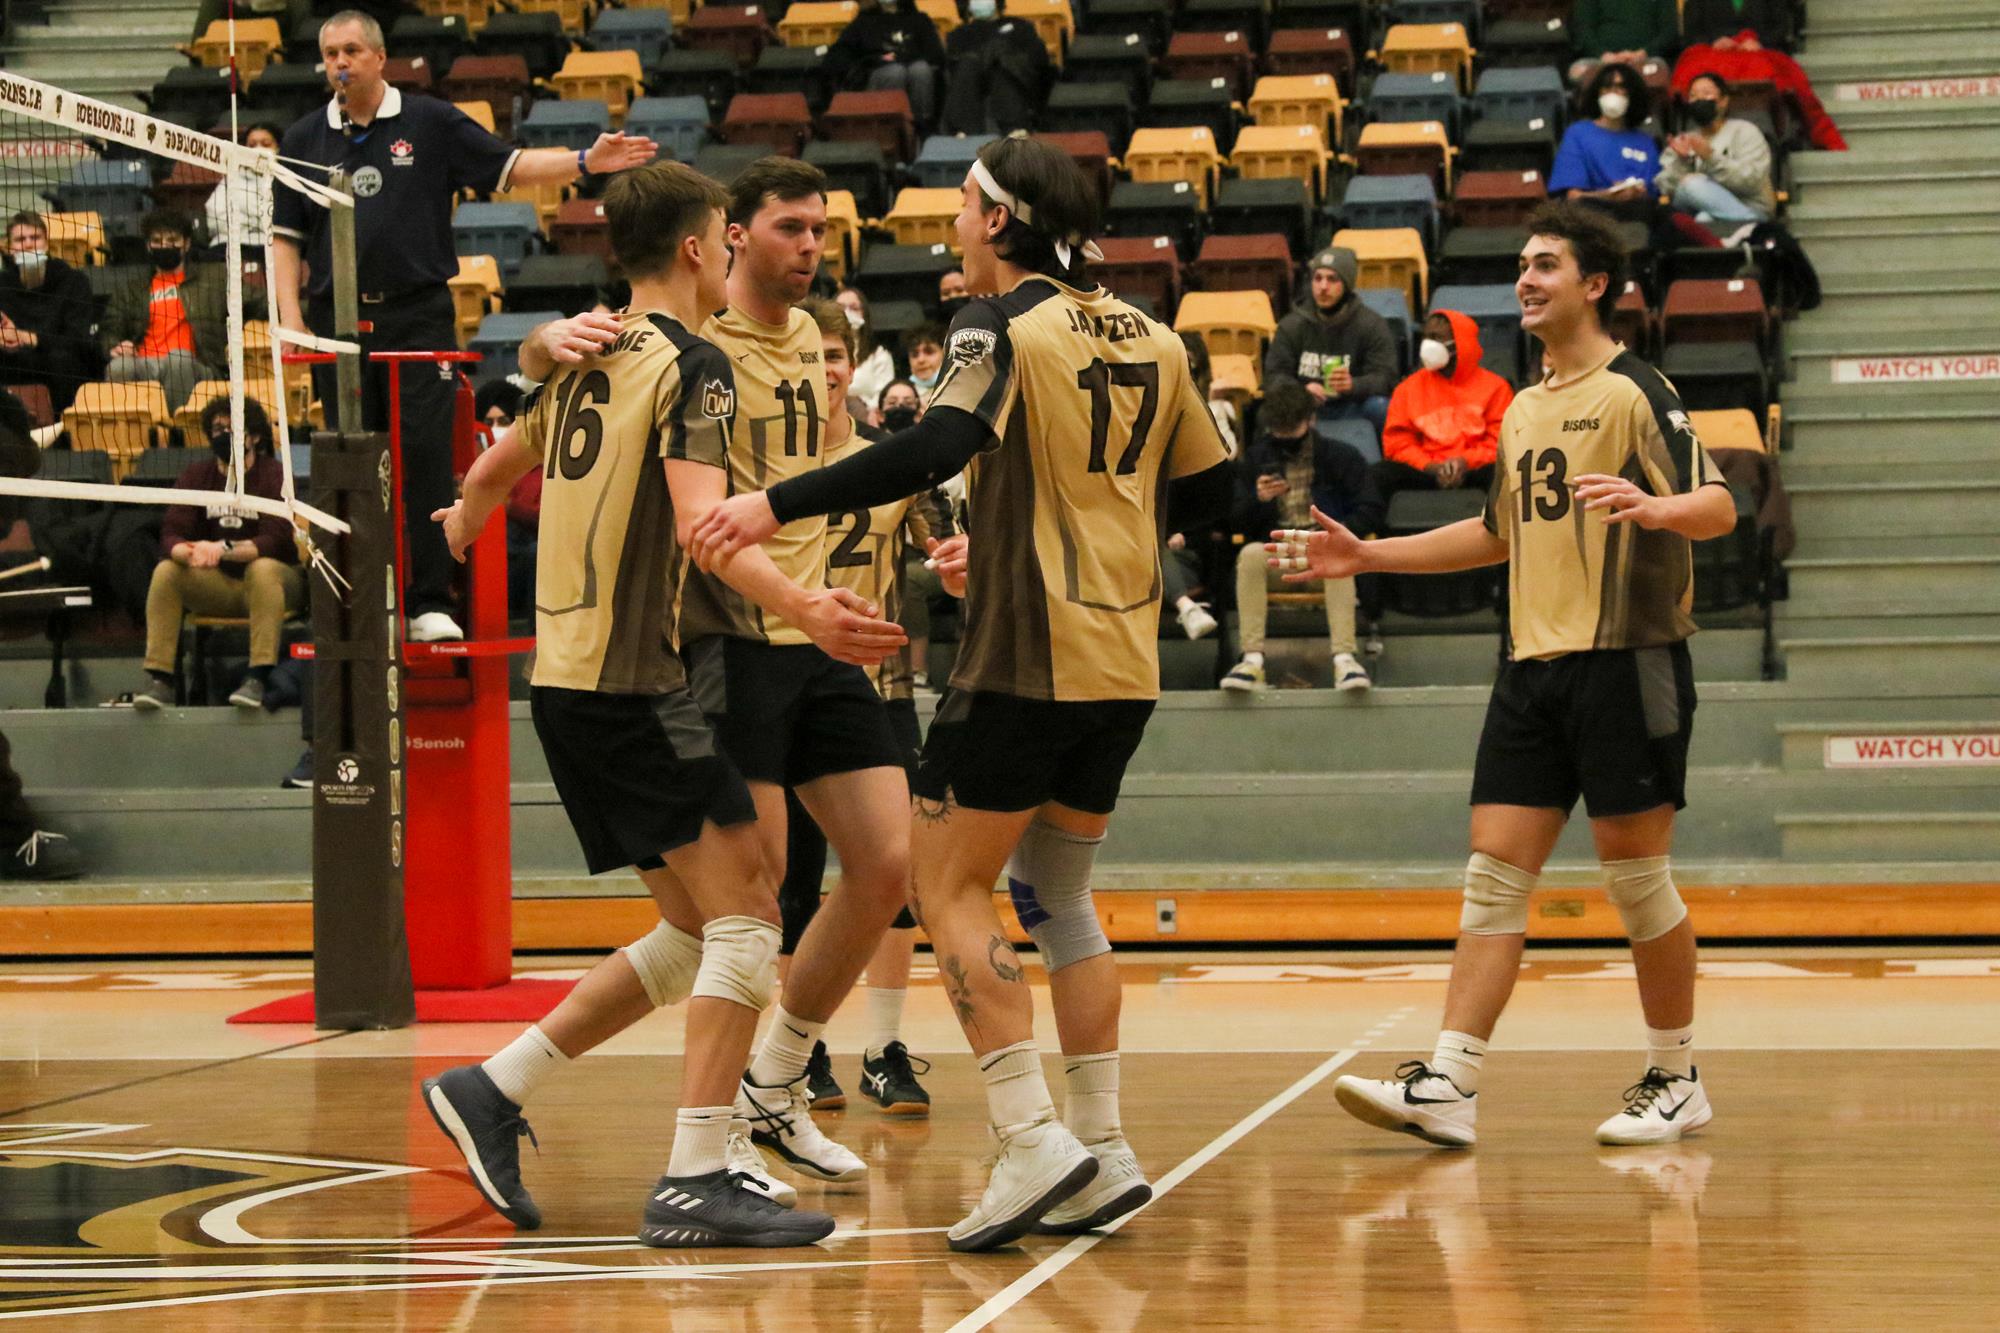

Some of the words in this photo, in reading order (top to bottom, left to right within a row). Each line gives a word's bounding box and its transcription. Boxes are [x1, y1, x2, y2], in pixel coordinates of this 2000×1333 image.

[1858, 83, 1923, 101] WATCH
[1929, 79, 1980, 98] YOUR
[1859, 360, 1934, 379] WATCH
[1941, 357, 2000, 377] YOUR
[546, 370, 610, 481] 16
[775, 379, 819, 457] 11
[1077, 357, 1159, 476] 17
[1562, 417, 1600, 432] BISONS
[1517, 447, 1570, 523] 13
[412, 736, 465, 750] Senoh
[1855, 738, 1944, 760] WATCH
